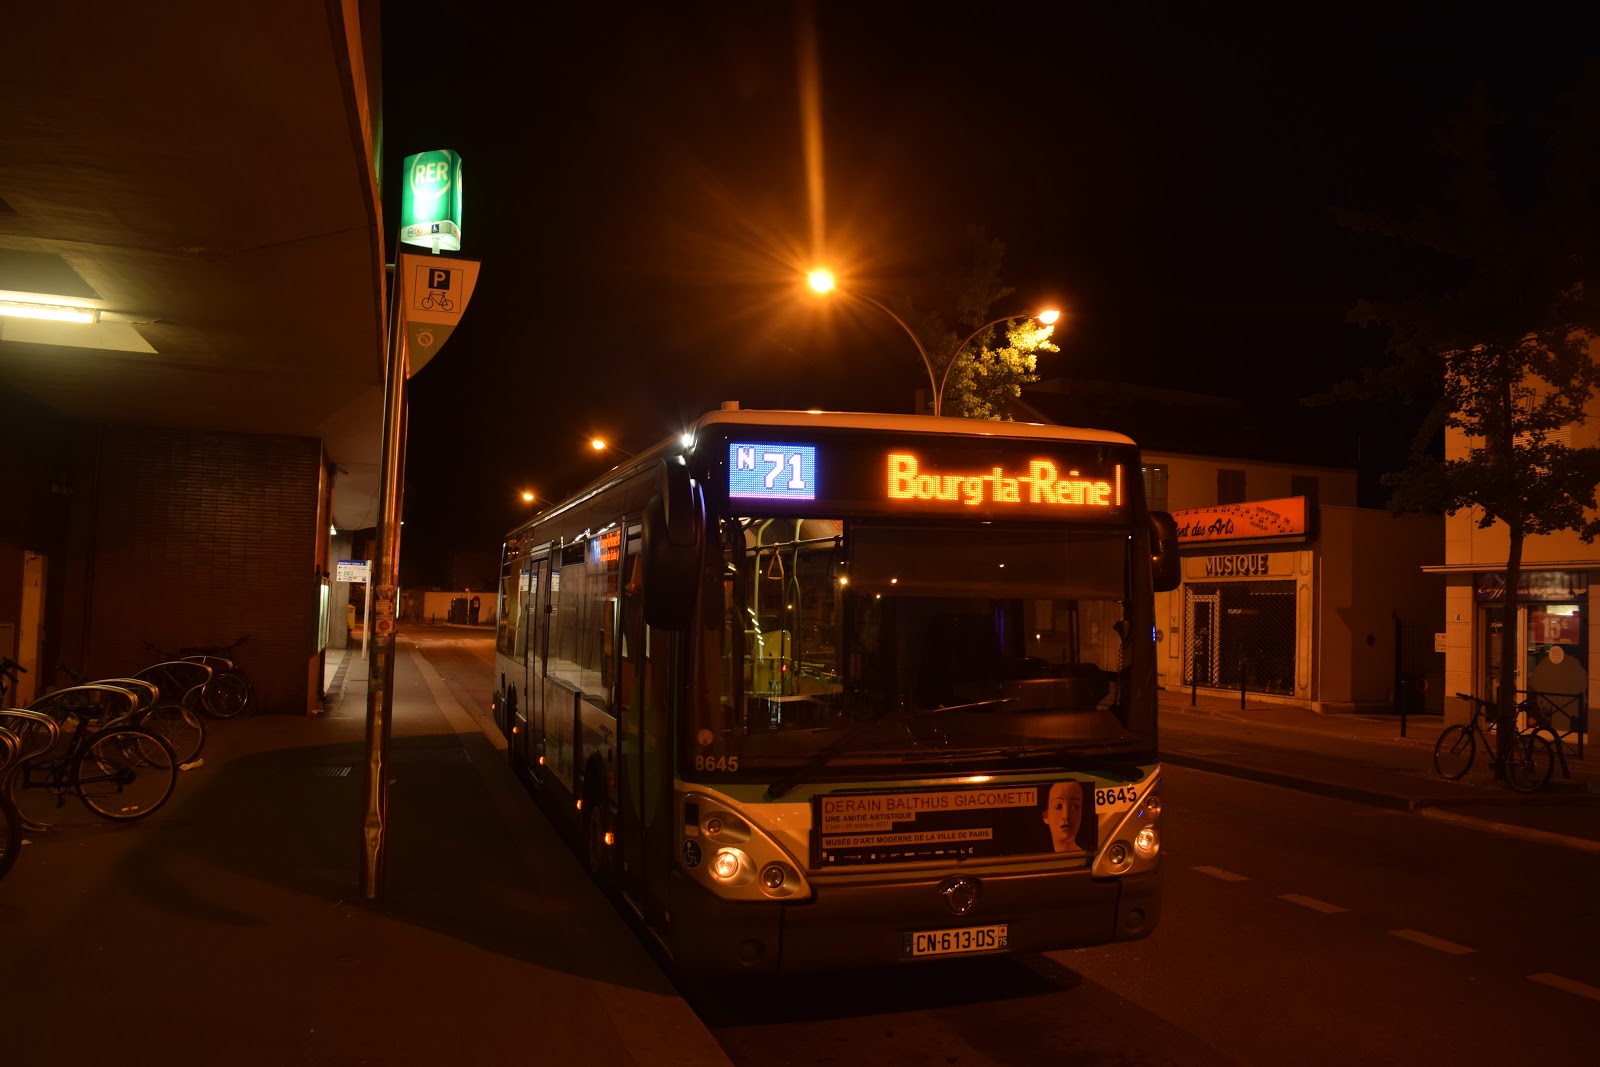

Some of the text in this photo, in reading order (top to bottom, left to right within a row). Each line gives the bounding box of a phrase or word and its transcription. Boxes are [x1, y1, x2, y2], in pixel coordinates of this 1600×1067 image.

[415, 161, 449, 185] RER
[433, 271, 446, 287] P
[737, 446, 806, 490] N 71
[887, 453, 1112, 506] Bourg-la-Reine
[1176, 518, 1234, 538] ont des Arts
[1205, 554, 1269, 577] MUSIQUE
[1541, 617, 1561, 639] 15
[694, 755, 739, 773] 8645
[824, 791, 1036, 814] DERAIN BALTHUS GIACOMETTI
[1096, 786, 1137, 806] 8645
[825, 815, 841, 823] UNE
[869, 812, 912, 821] ARTISTIQUE
[853, 836, 875, 845] D'ART
[876, 834, 912, 844] MODERNE
[914, 832, 924, 841] DE
[925, 831, 936, 840] LA
[936, 830, 956, 840] VILLE
[957, 829, 969, 839] DE
[969, 828, 990, 838] PARIS
[916, 929, 995, 953] CN-613-DS
[999, 938, 1007, 946] 75
